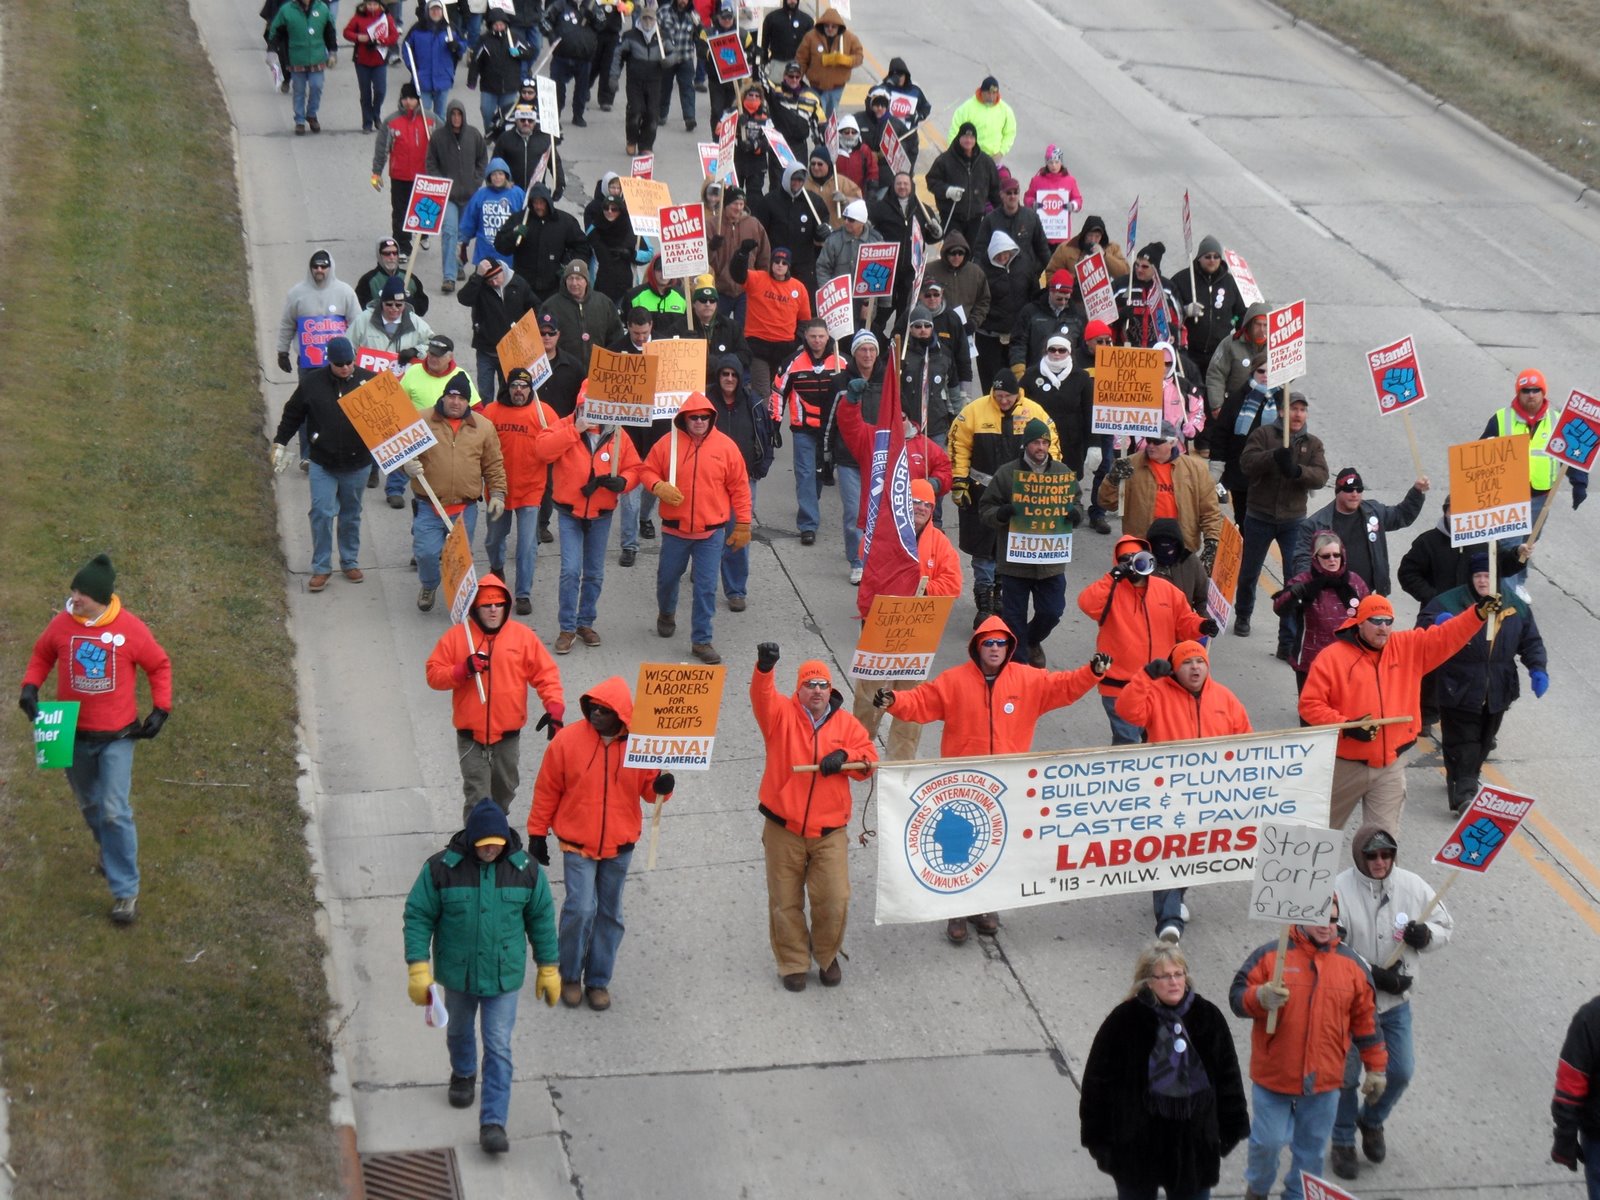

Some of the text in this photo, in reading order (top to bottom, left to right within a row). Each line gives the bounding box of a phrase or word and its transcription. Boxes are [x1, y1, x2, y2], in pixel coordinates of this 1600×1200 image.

[891, 102, 911, 114] STOP
[416, 180, 448, 193] Stand!
[482, 203, 511, 216] RECALL
[1042, 201, 1063, 210] STOP
[669, 208, 688, 224] ON
[663, 217, 702, 240] STRIKE
[664, 243, 688, 251] DIST.
[666, 248, 702, 257] IAMAW-
[861, 246, 896, 259] Stand!
[666, 254, 704, 264] AFL-CIO
[1083, 259, 1095, 277] ON
[1081, 266, 1106, 295] STRIKE
[823, 282, 836, 299] ON
[1102, 288, 1110, 296] 10
[818, 287, 848, 317] STRIKE
[1090, 300, 1113, 317] AFL-CIO
[827, 313, 848, 325] MAW-
[1276, 309, 1293, 328] ON
[1270, 316, 1303, 348] STRIKE
[1293, 340, 1303, 349] 10
[596, 349, 647, 373] LIUNA
[1101, 350, 1158, 369] LABORERS
[1370, 340, 1412, 367] Stand!
[1270, 355, 1303, 373] AFL-CIO
[592, 368, 647, 385] SUPPORTS
[1117, 369, 1136, 381] FOR
[604, 384, 634, 395] LOCAL
[1097, 379, 1151, 393] COLLECTIVE
[343, 374, 399, 420] LOCAL 516
[1098, 392, 1153, 403] BARGAINING
[362, 400, 395, 428] BUILDS
[586, 412, 614, 421] BUILDS
[587, 402, 650, 417] LiUNA!
[1095, 408, 1159, 425] LiUNA!
[1095, 422, 1158, 433] BUILDS AMERICA
[375, 423, 428, 463] LiUNA!
[381, 435, 433, 470] BUILDS AMERICA
[1460, 439, 1518, 471] LIUNA
[1465, 464, 1506, 483] SUPPORTS
[1024, 484, 1070, 494] SUPPORT
[1475, 478, 1503, 494] LOCAL
[1012, 493, 1076, 504] MACHINIST
[1477, 491, 1501, 510] 516
[1024, 506, 1069, 517] LOCAL
[1454, 506, 1527, 533] LiUNA!
[1454, 522, 1528, 541] BUILDS AMERICA
[1010, 535, 1070, 552] LiUNA!
[1009, 550, 1069, 559] BUILDS AMERICA
[877, 600, 935, 615] LIUNA
[875, 613, 935, 626] SUPPORTS
[885, 628, 916, 639] LOCAL
[882, 639, 909, 653] 516
[855, 654, 930, 670] LiUNA!
[645, 669, 715, 682] WISCONSIN
[852, 667, 926, 676] BUILDS AMERICA
[645, 682, 709, 696] LABORERS
[668, 697, 685, 705] FOR
[35, 710, 63, 725] Pull
[653, 705, 699, 715] WORKERS
[656, 716, 702, 730] RIGHTS
[629, 738, 710, 756] LiUNA!
[628, 754, 707, 765] BUILDS AMERICA
[1043, 744, 1314, 780] CONSTRUCTION UTILITY
[917, 774, 1000, 801] LABORERS LOCAL 113
[1041, 763, 1303, 800] BUILDING PLUMBING
[1055, 786, 1279, 818] SEWER & TUNNEL
[1476, 791, 1530, 817] Stand!
[909, 787, 1003, 856] LABORERS INTERNATIONAL UNION
[1039, 801, 1296, 840] PLASTER & PAVING
[1056, 826, 1257, 871] LABORERS
[1262, 826, 1334, 866] Stop
[1050, 877, 1080, 892] #113
[1099, 868, 1160, 888] MILW.
[1170, 857, 1257, 878] WISCON
[1261, 860, 1332, 890] Corp.
[1253, 886, 1332, 918] Greed
